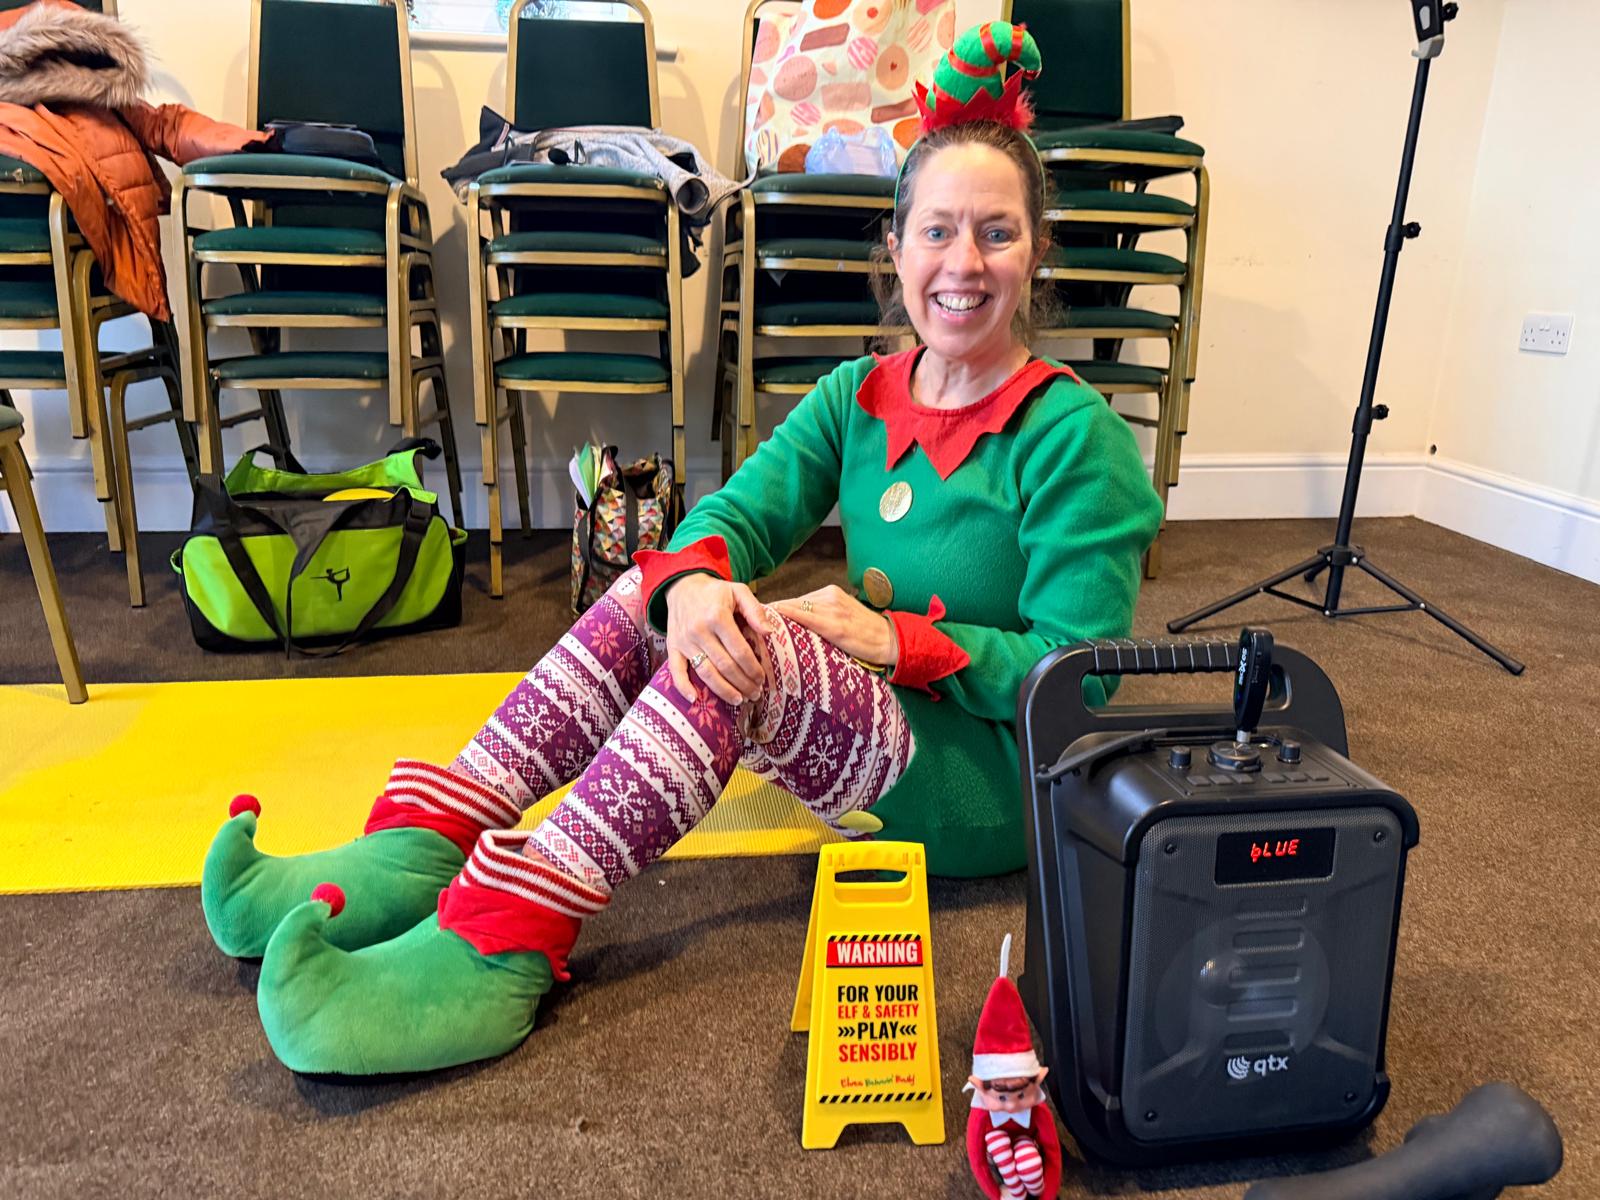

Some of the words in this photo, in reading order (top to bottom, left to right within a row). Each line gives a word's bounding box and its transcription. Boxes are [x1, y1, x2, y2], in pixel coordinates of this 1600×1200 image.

[836, 942, 918, 964] WARNING
[837, 985, 869, 1002] FOR
[875, 984, 918, 1002] YOUR
[837, 1005, 858, 1019] ELF
[862, 1004, 870, 1018] &
[875, 1003, 919, 1018] SAFETY
[857, 1021, 899, 1040] PLAY
[838, 1042, 917, 1063] SENSIBLY
[1253, 1054, 1289, 1077] qtx
